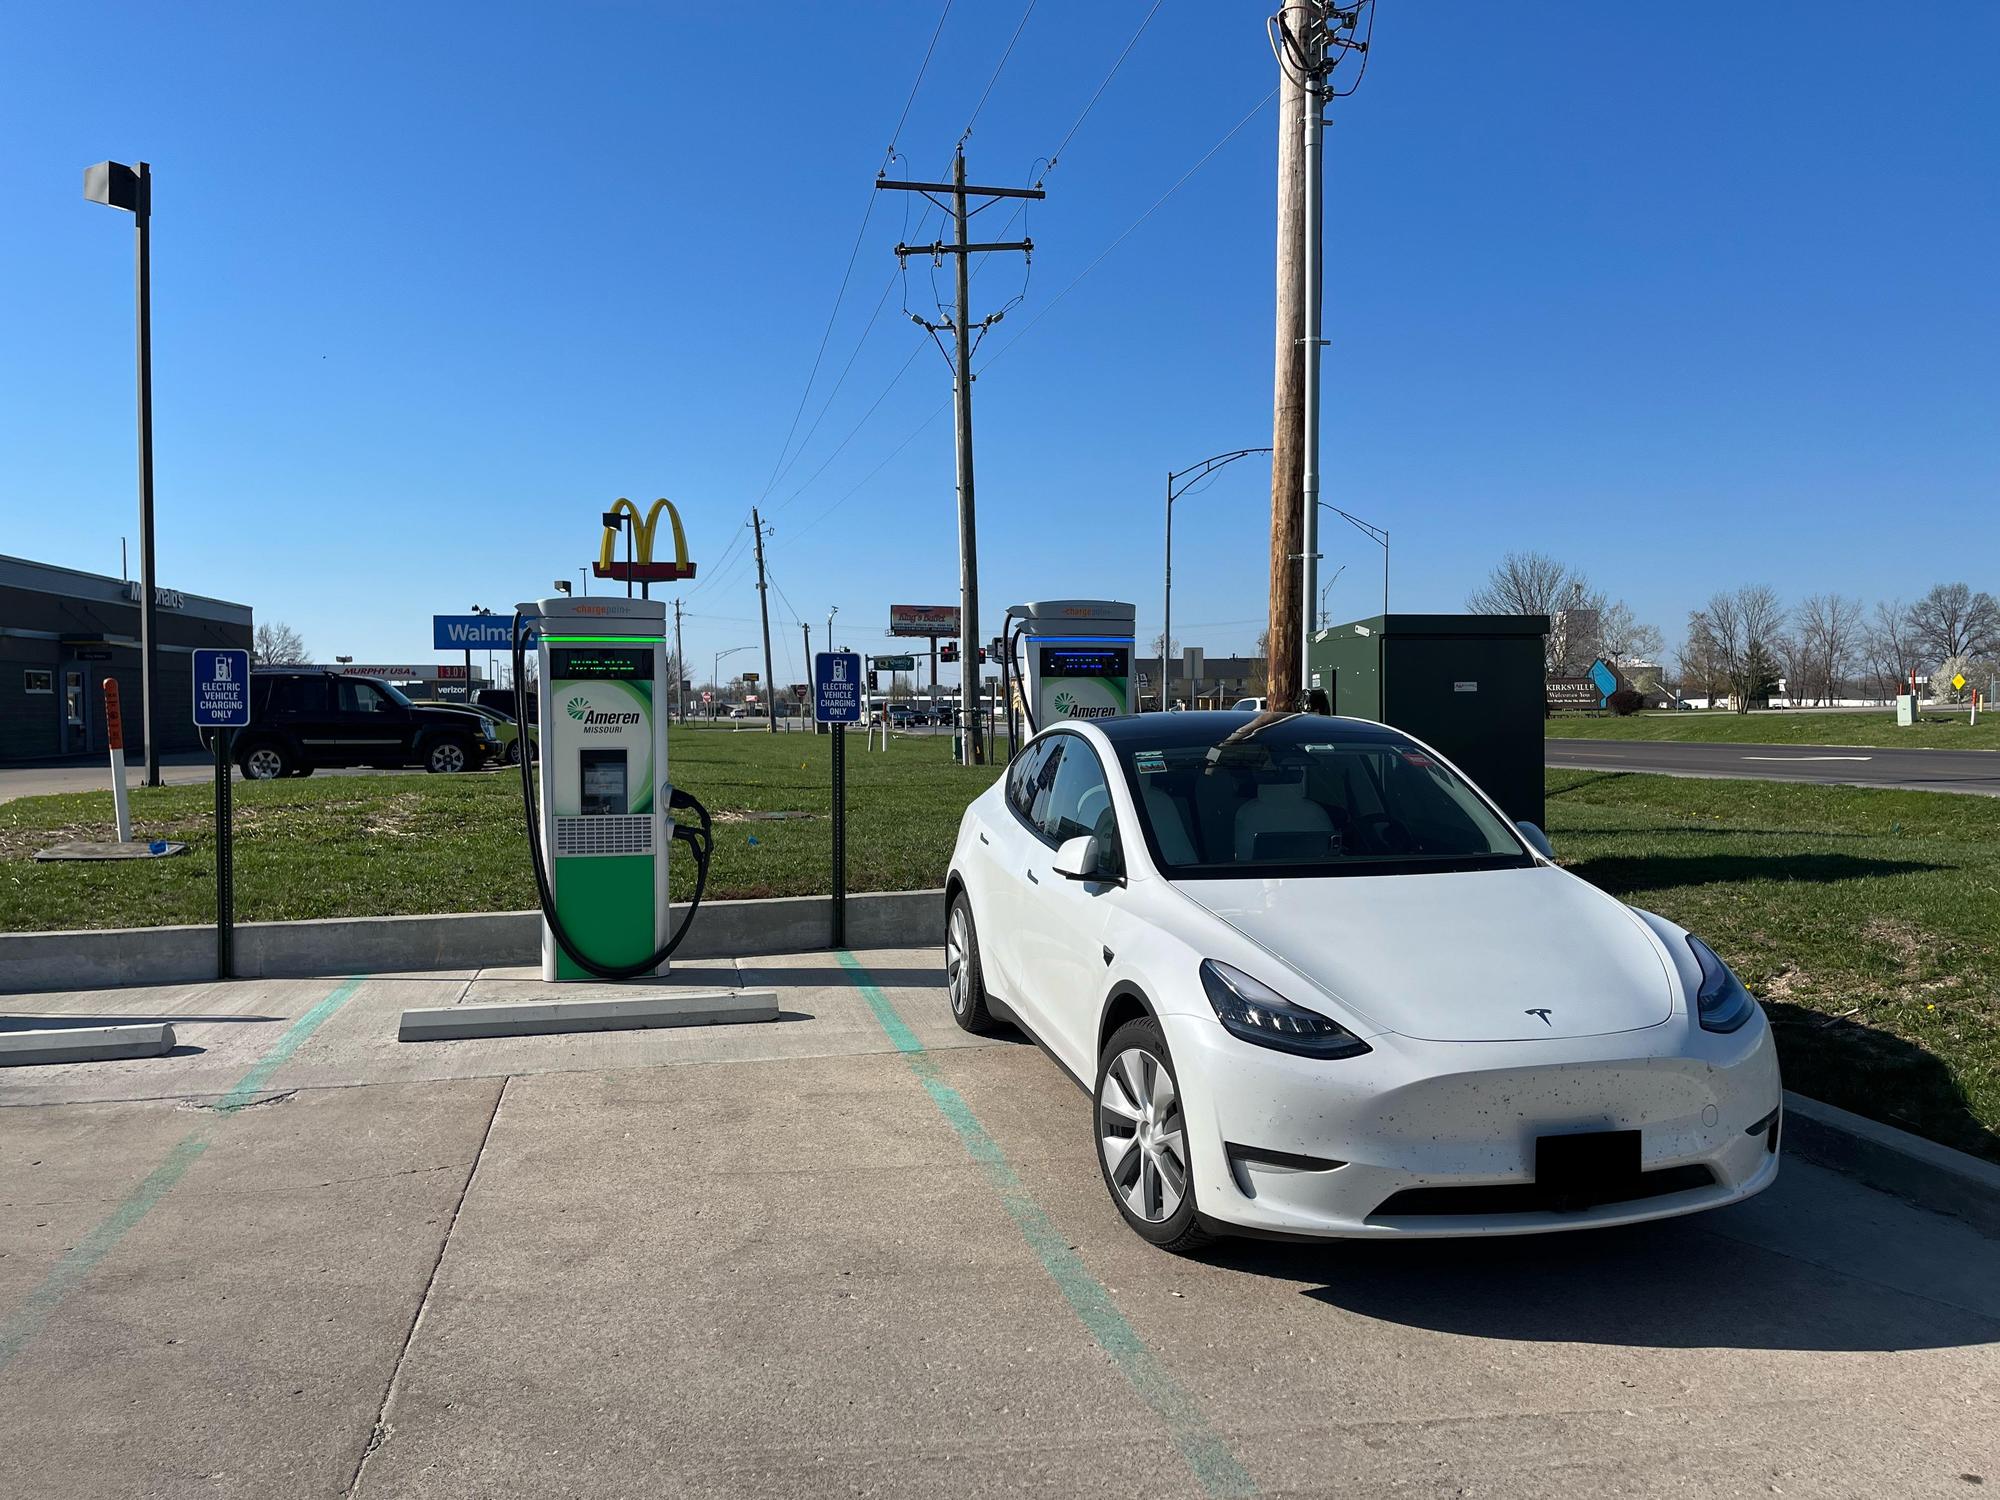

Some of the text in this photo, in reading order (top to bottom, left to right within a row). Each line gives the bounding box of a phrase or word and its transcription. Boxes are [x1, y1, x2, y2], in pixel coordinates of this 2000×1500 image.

[343, 667, 411, 675] MURPHY USA
[202, 682, 241, 691] ELECTRIC
[822, 682, 854, 691] ELECTRIC
[1546, 683, 1596, 691] KIRKSVILLE
[204, 691, 239, 700] VEHICLE
[824, 691, 852, 699] VEHICLE
[200, 701, 243, 710] CHARGING
[820, 699, 856, 707] CHARGING
[211, 710, 232, 719] ONLY
[829, 707, 847, 716] ONLY
[1068, 704, 1116, 718] Ameren
[584, 710, 640, 725] Ameren
[583, 726, 623, 734] MISSOURI
